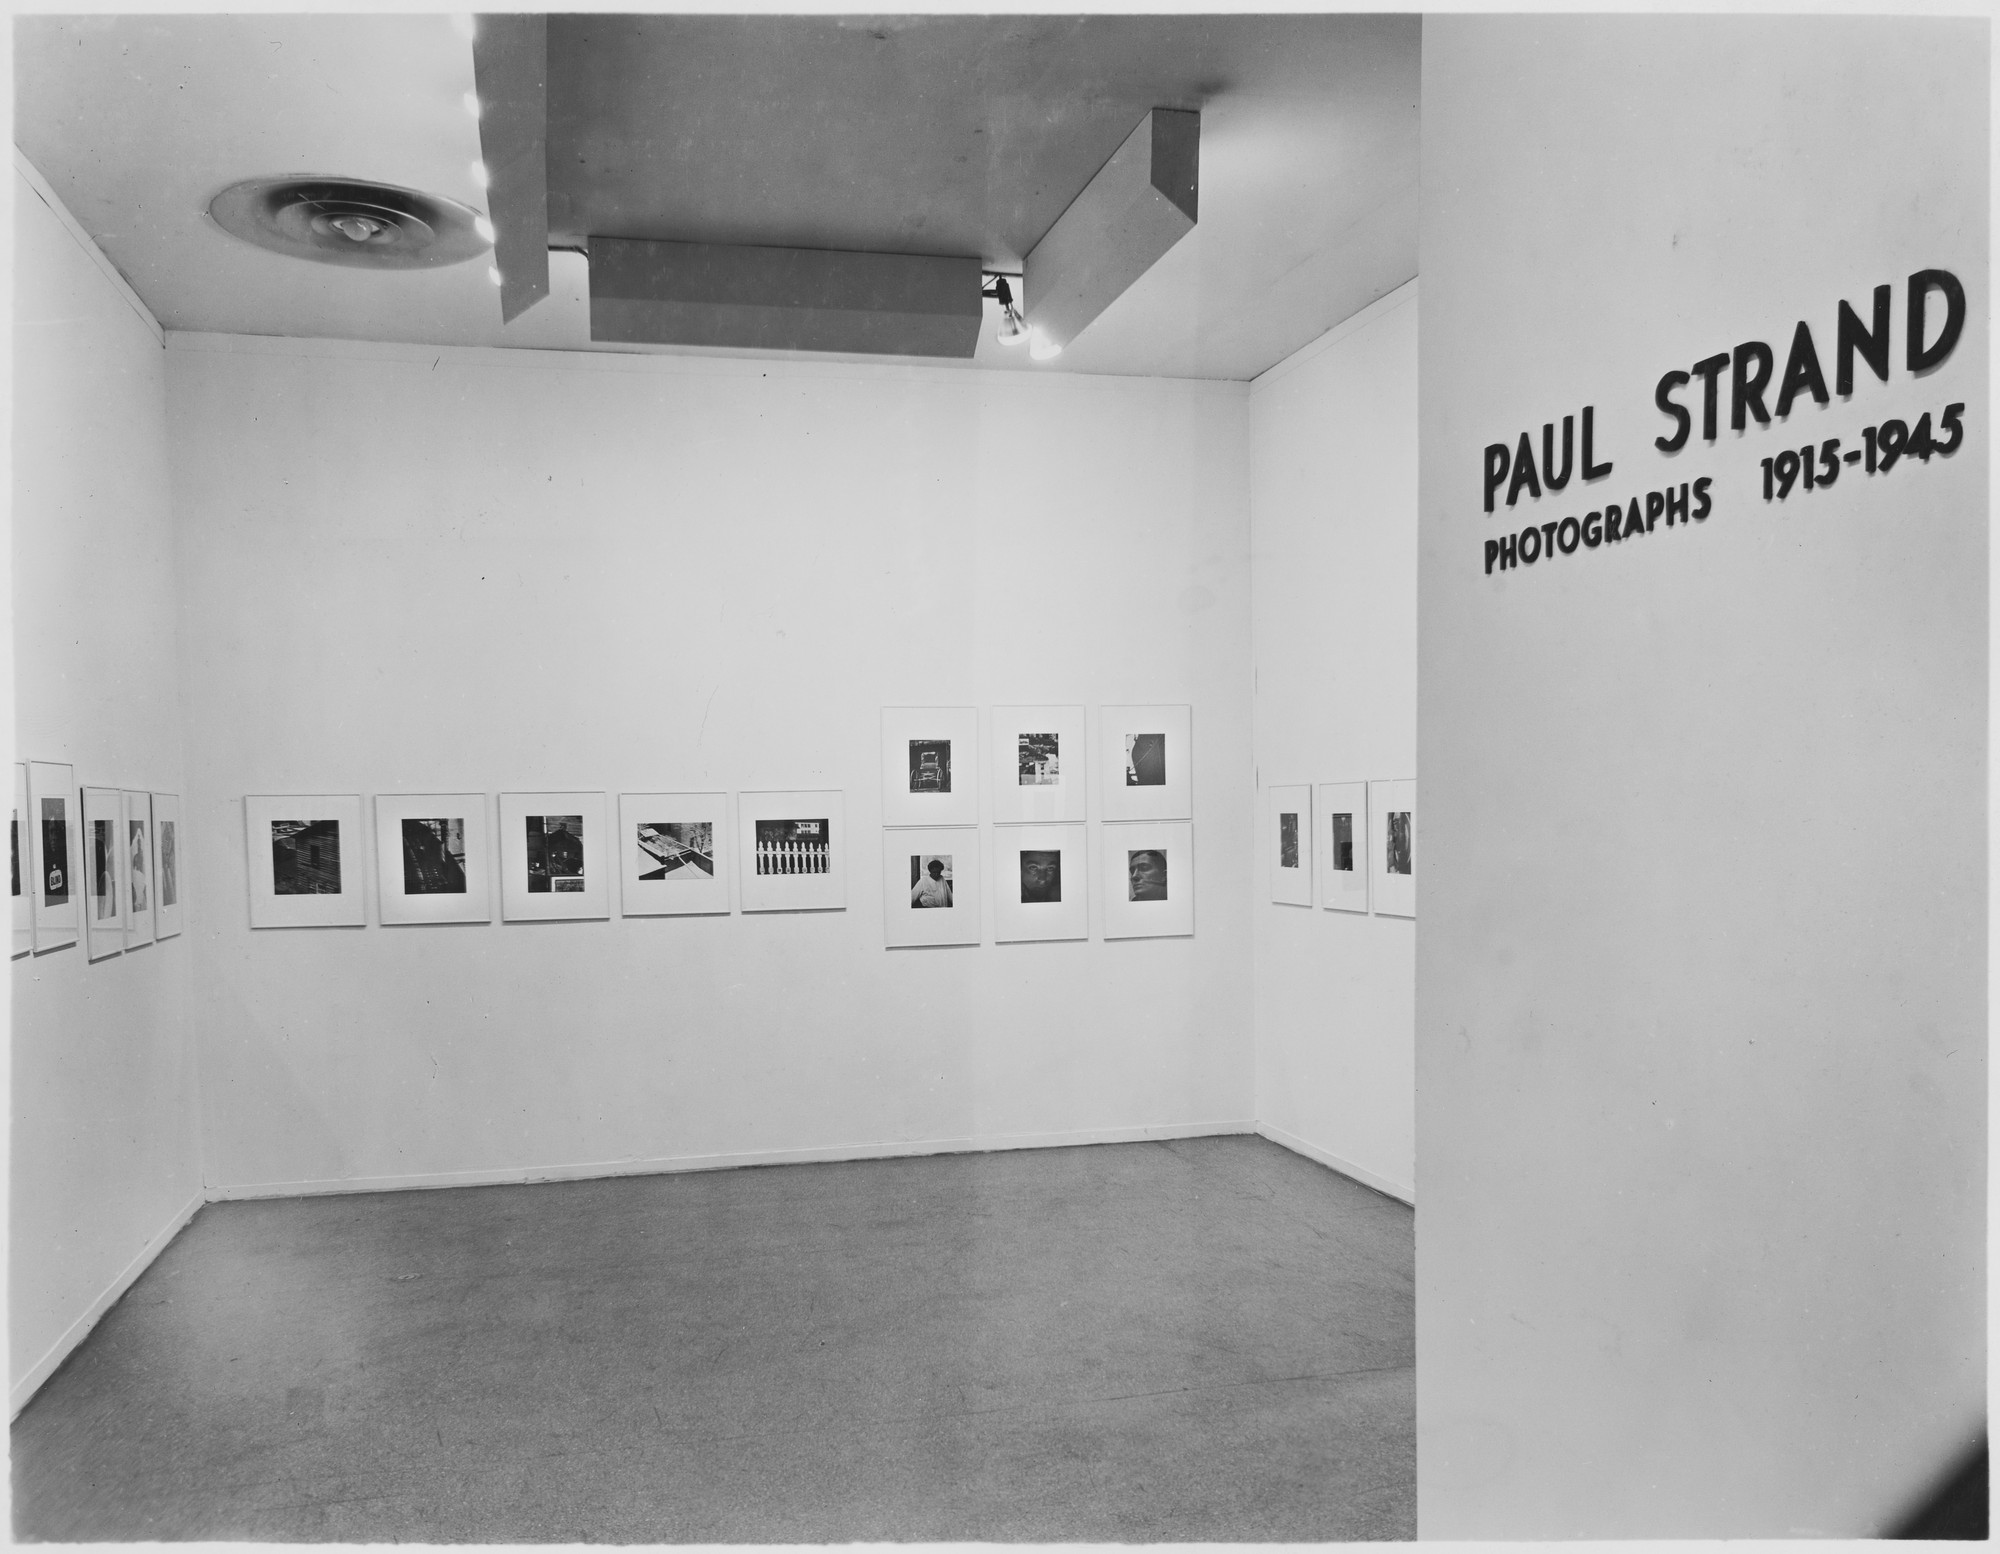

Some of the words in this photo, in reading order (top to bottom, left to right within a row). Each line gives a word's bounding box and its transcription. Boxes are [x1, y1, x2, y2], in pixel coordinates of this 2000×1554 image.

[1484, 477, 1713, 575] PHOTOGRAPHS
[1761, 402, 1965, 501] 1915-1945
[1485, 406, 1612, 514] PAUL
[1655, 269, 1966, 453] STRAND
